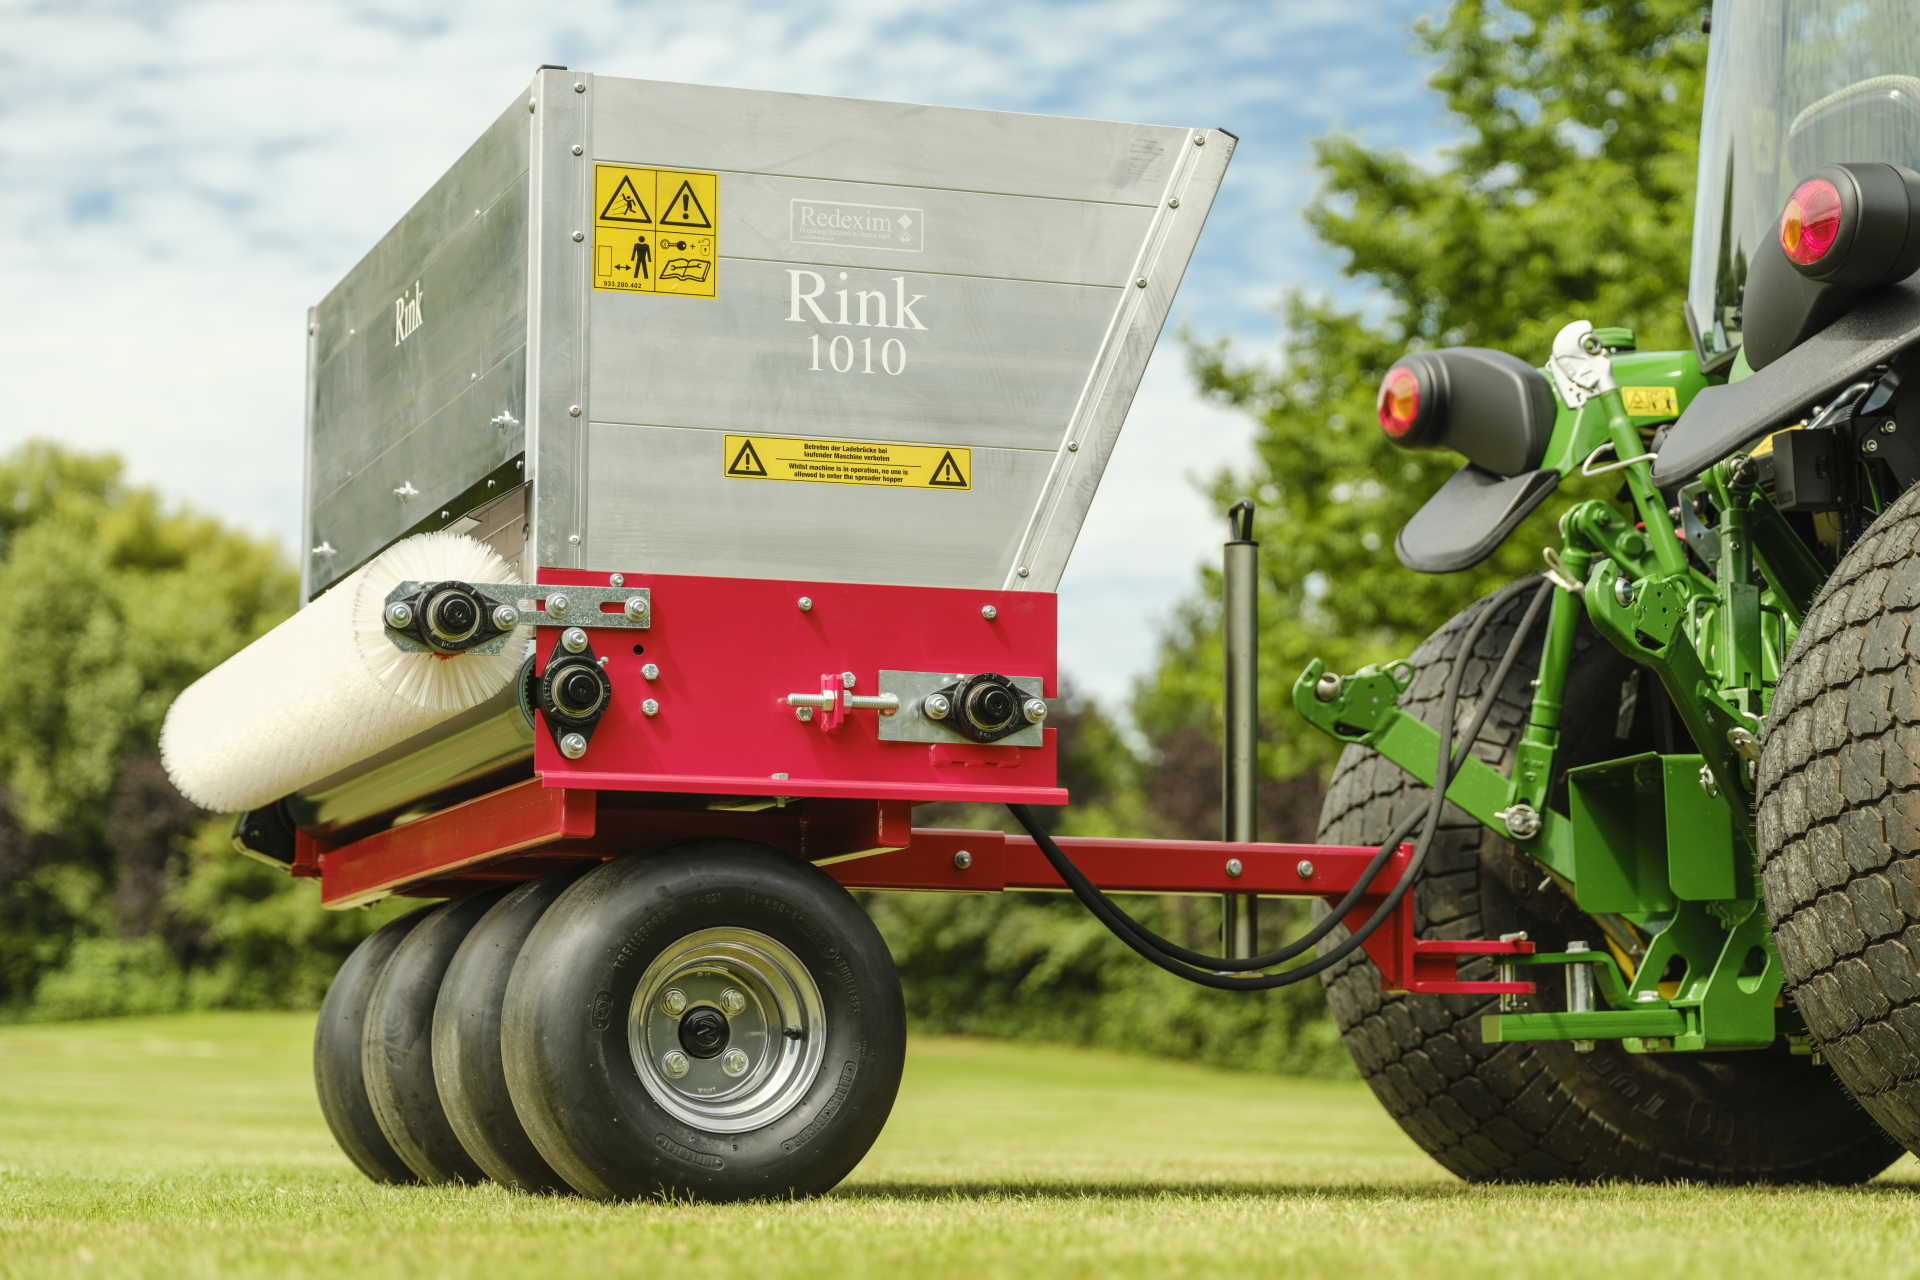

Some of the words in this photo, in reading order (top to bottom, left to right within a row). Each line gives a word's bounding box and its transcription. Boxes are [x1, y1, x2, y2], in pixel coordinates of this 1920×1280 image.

[799, 205, 893, 232] Redexim
[799, 226, 827, 236] Breaking
[828, 228, 852, 237] barriers
[860, 230, 878, 239] better
[603, 280, 642, 289] 933.280.402
[784, 268, 930, 331] Rink
[394, 279, 424, 348] Rink
[807, 333, 907, 376] 1010
[804, 443, 830, 451] Betreten
[831, 444, 842, 452] der
[842, 445, 877, 454] Ladebrücke
[804, 450, 833, 459] laufender
[833, 452, 863, 461] Maschine
[863, 454, 890, 462] verboten
[788, 462, 808, 470] Whilst
[809, 464, 835, 472] machine
[843, 465, 849, 473] in
[850, 466, 881, 475] operation,
[902, 468, 909, 476] is
[793, 470, 818, 478] allowed
[826, 472, 843, 480] enter
[843, 473, 854, 481] the
[854, 474, 882, 482] spreader
[882, 475, 904, 484] hopper
[613, 910, 668, 969] TRELLEBORG
